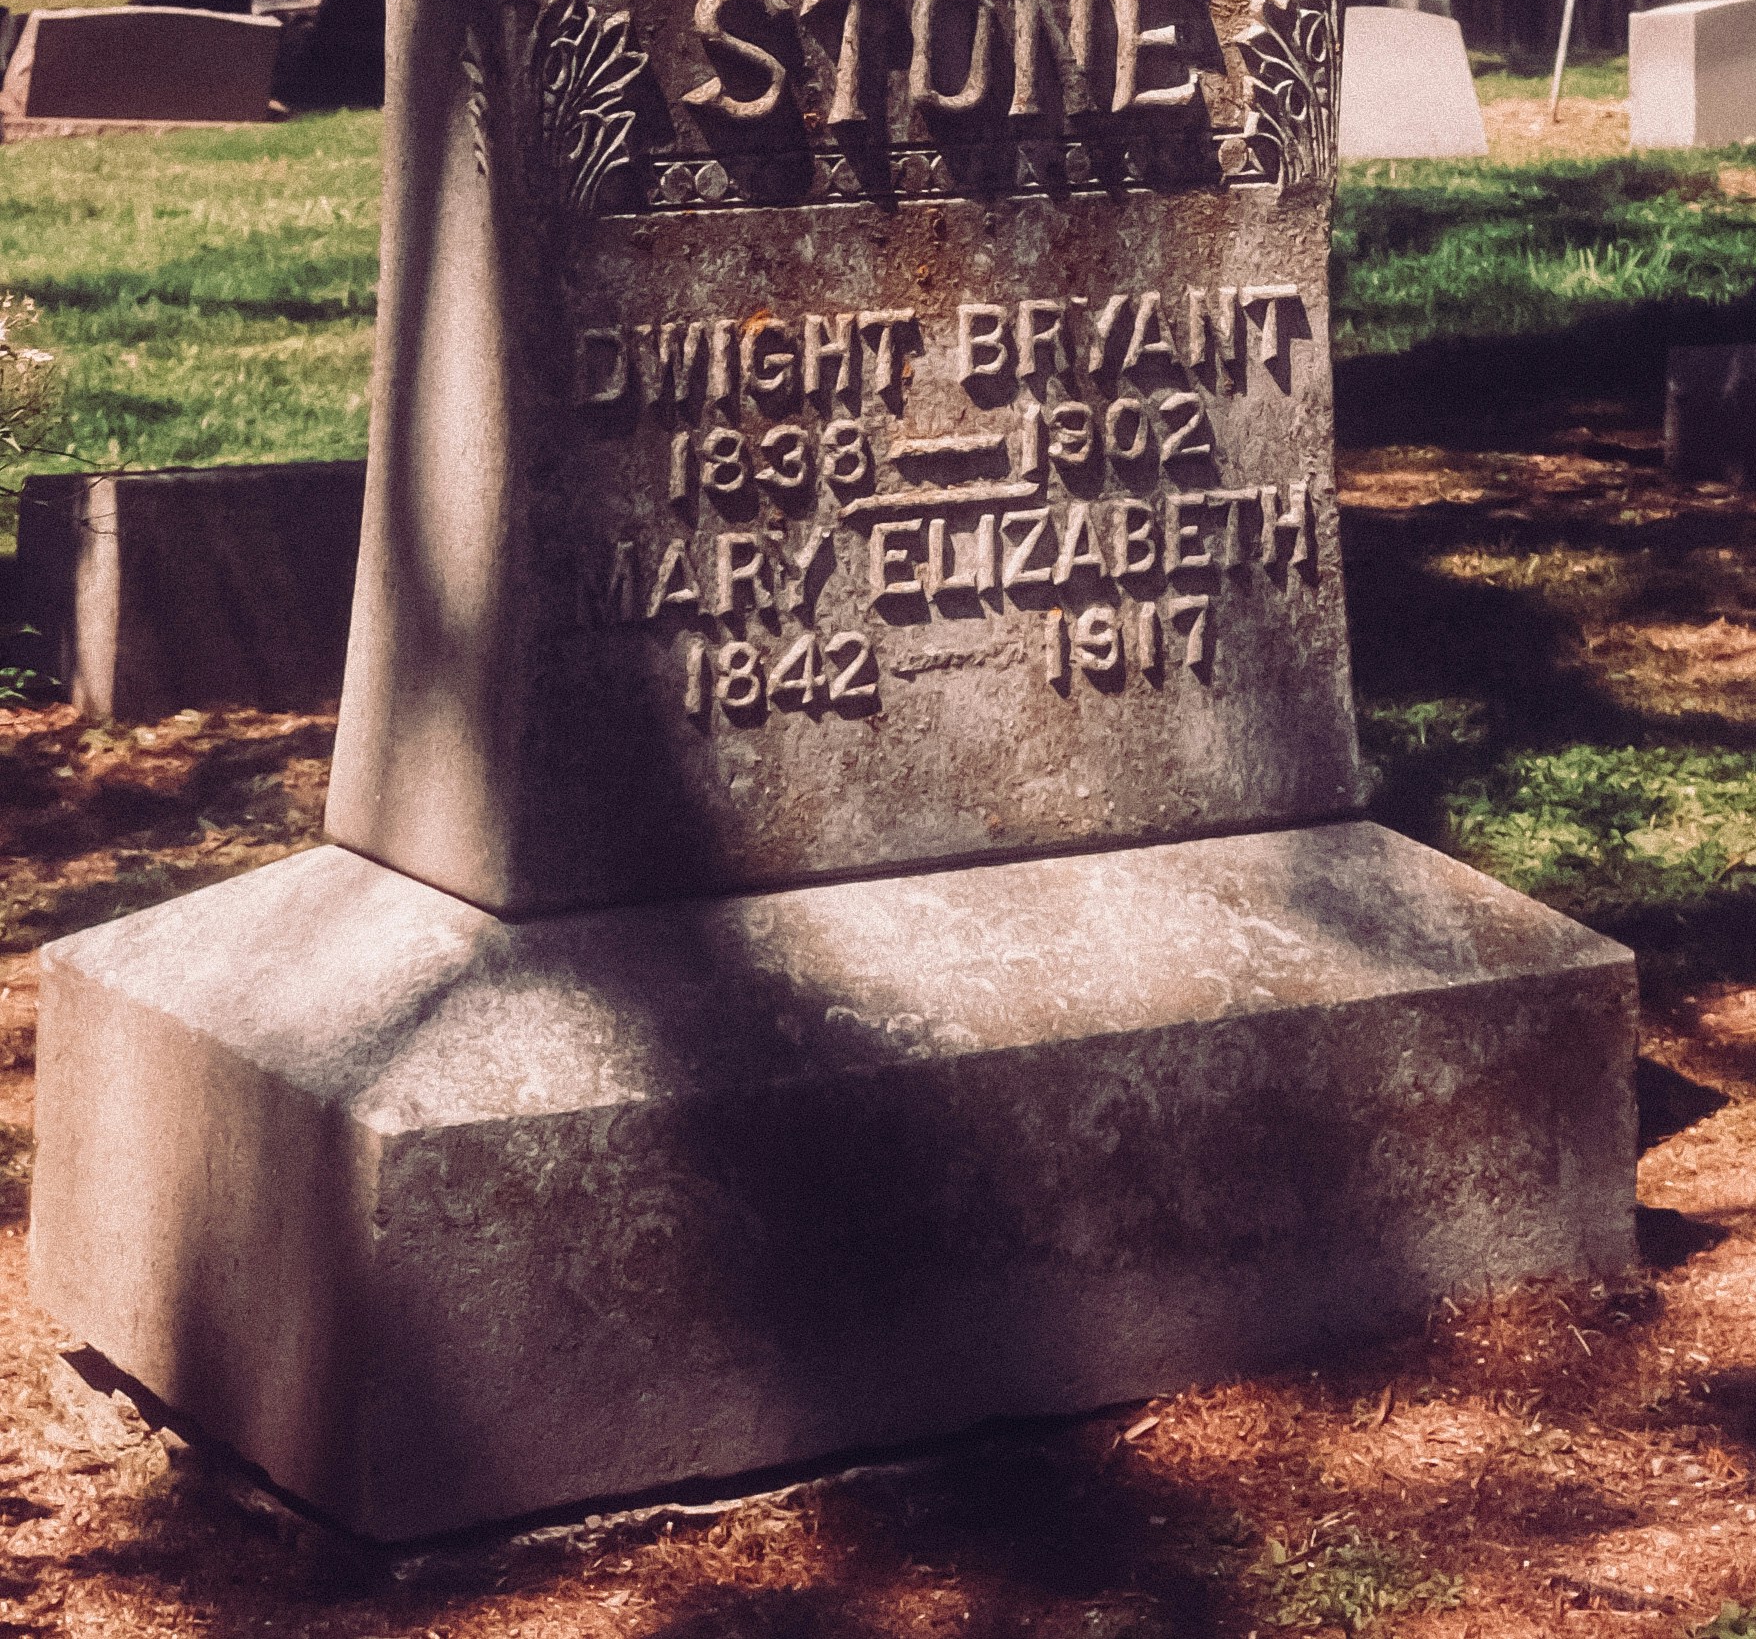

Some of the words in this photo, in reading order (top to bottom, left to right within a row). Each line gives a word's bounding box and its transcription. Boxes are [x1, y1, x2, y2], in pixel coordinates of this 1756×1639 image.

[580, 309, 916, 403] DWIGHT
[958, 285, 1304, 381] BRYANT
[668, 419, 870, 503] 1838
[1022, 393, 1212, 479] 1902
[578, 533, 832, 619] MARY
[870, 486, 1309, 595] ELIZABETH
[686, 633, 878, 711] 1842
[1045, 596, 1211, 679] 1917
